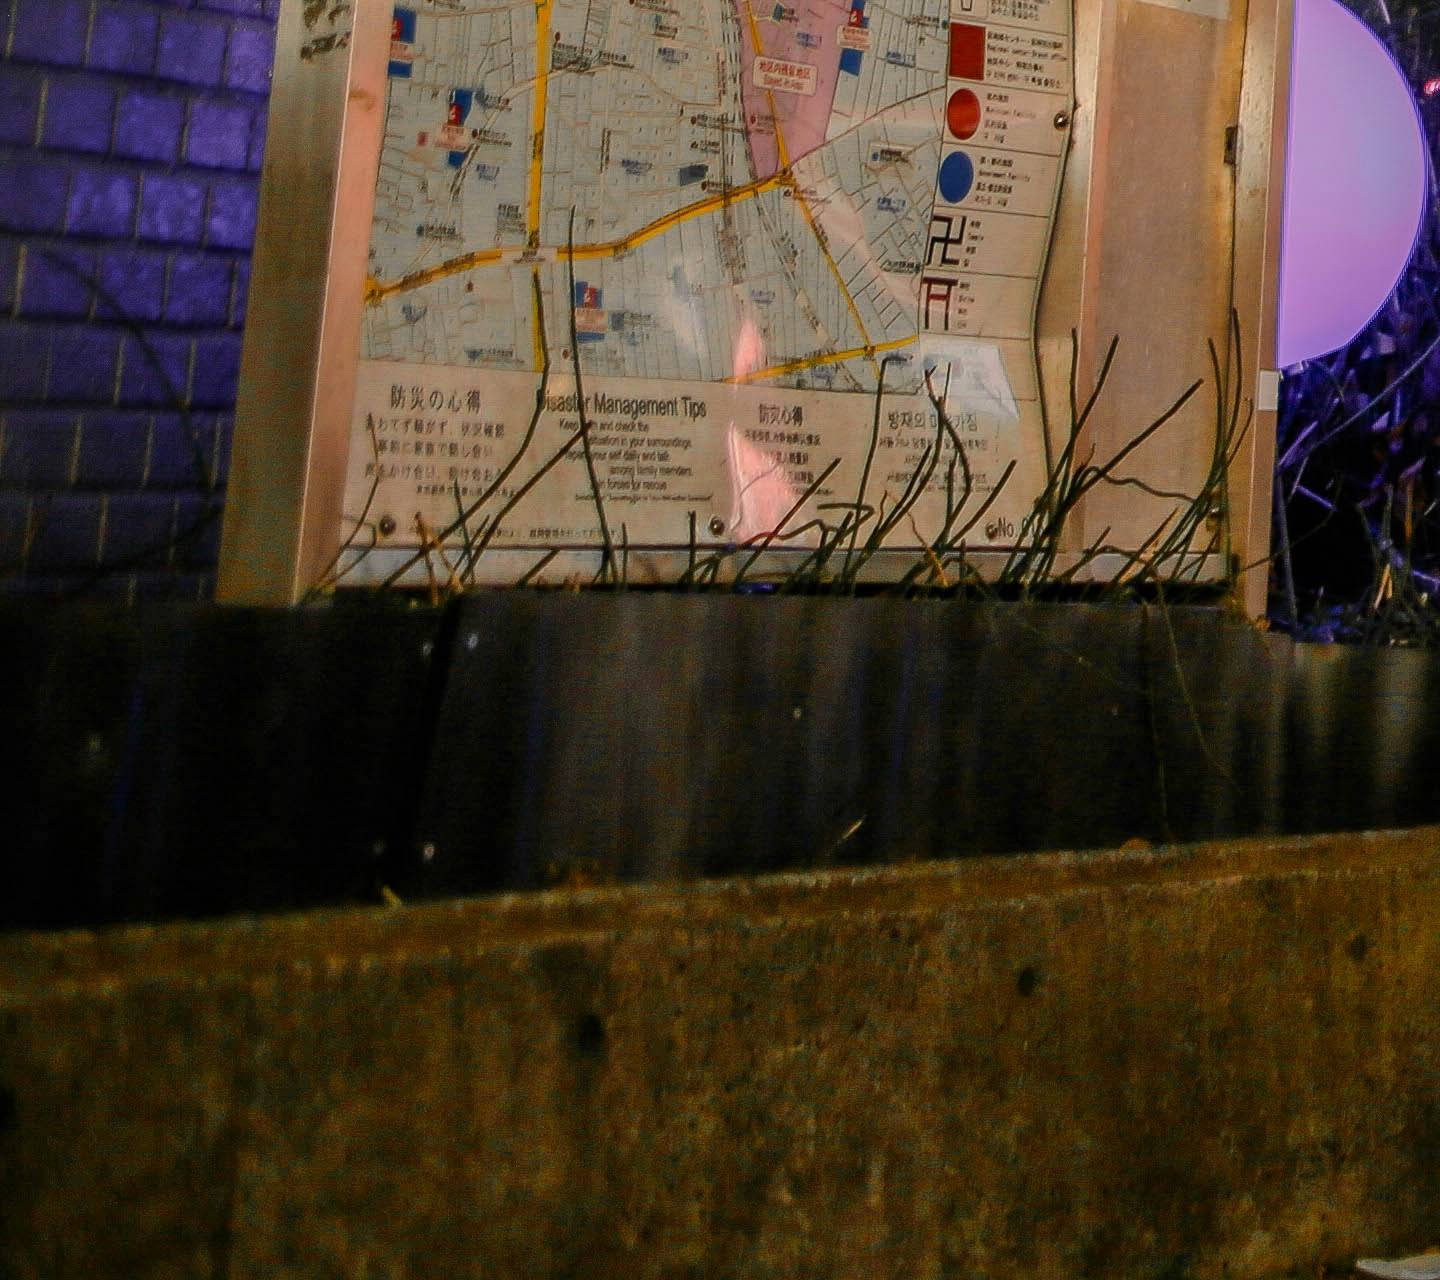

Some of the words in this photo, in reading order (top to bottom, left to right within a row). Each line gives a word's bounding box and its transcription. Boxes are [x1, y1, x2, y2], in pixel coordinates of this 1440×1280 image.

[390, 385, 481, 413] 防災の心得
[545, 391, 591, 414] isastr
[594, 392, 678, 419] Management
[682, 396, 707, 421] Tips
